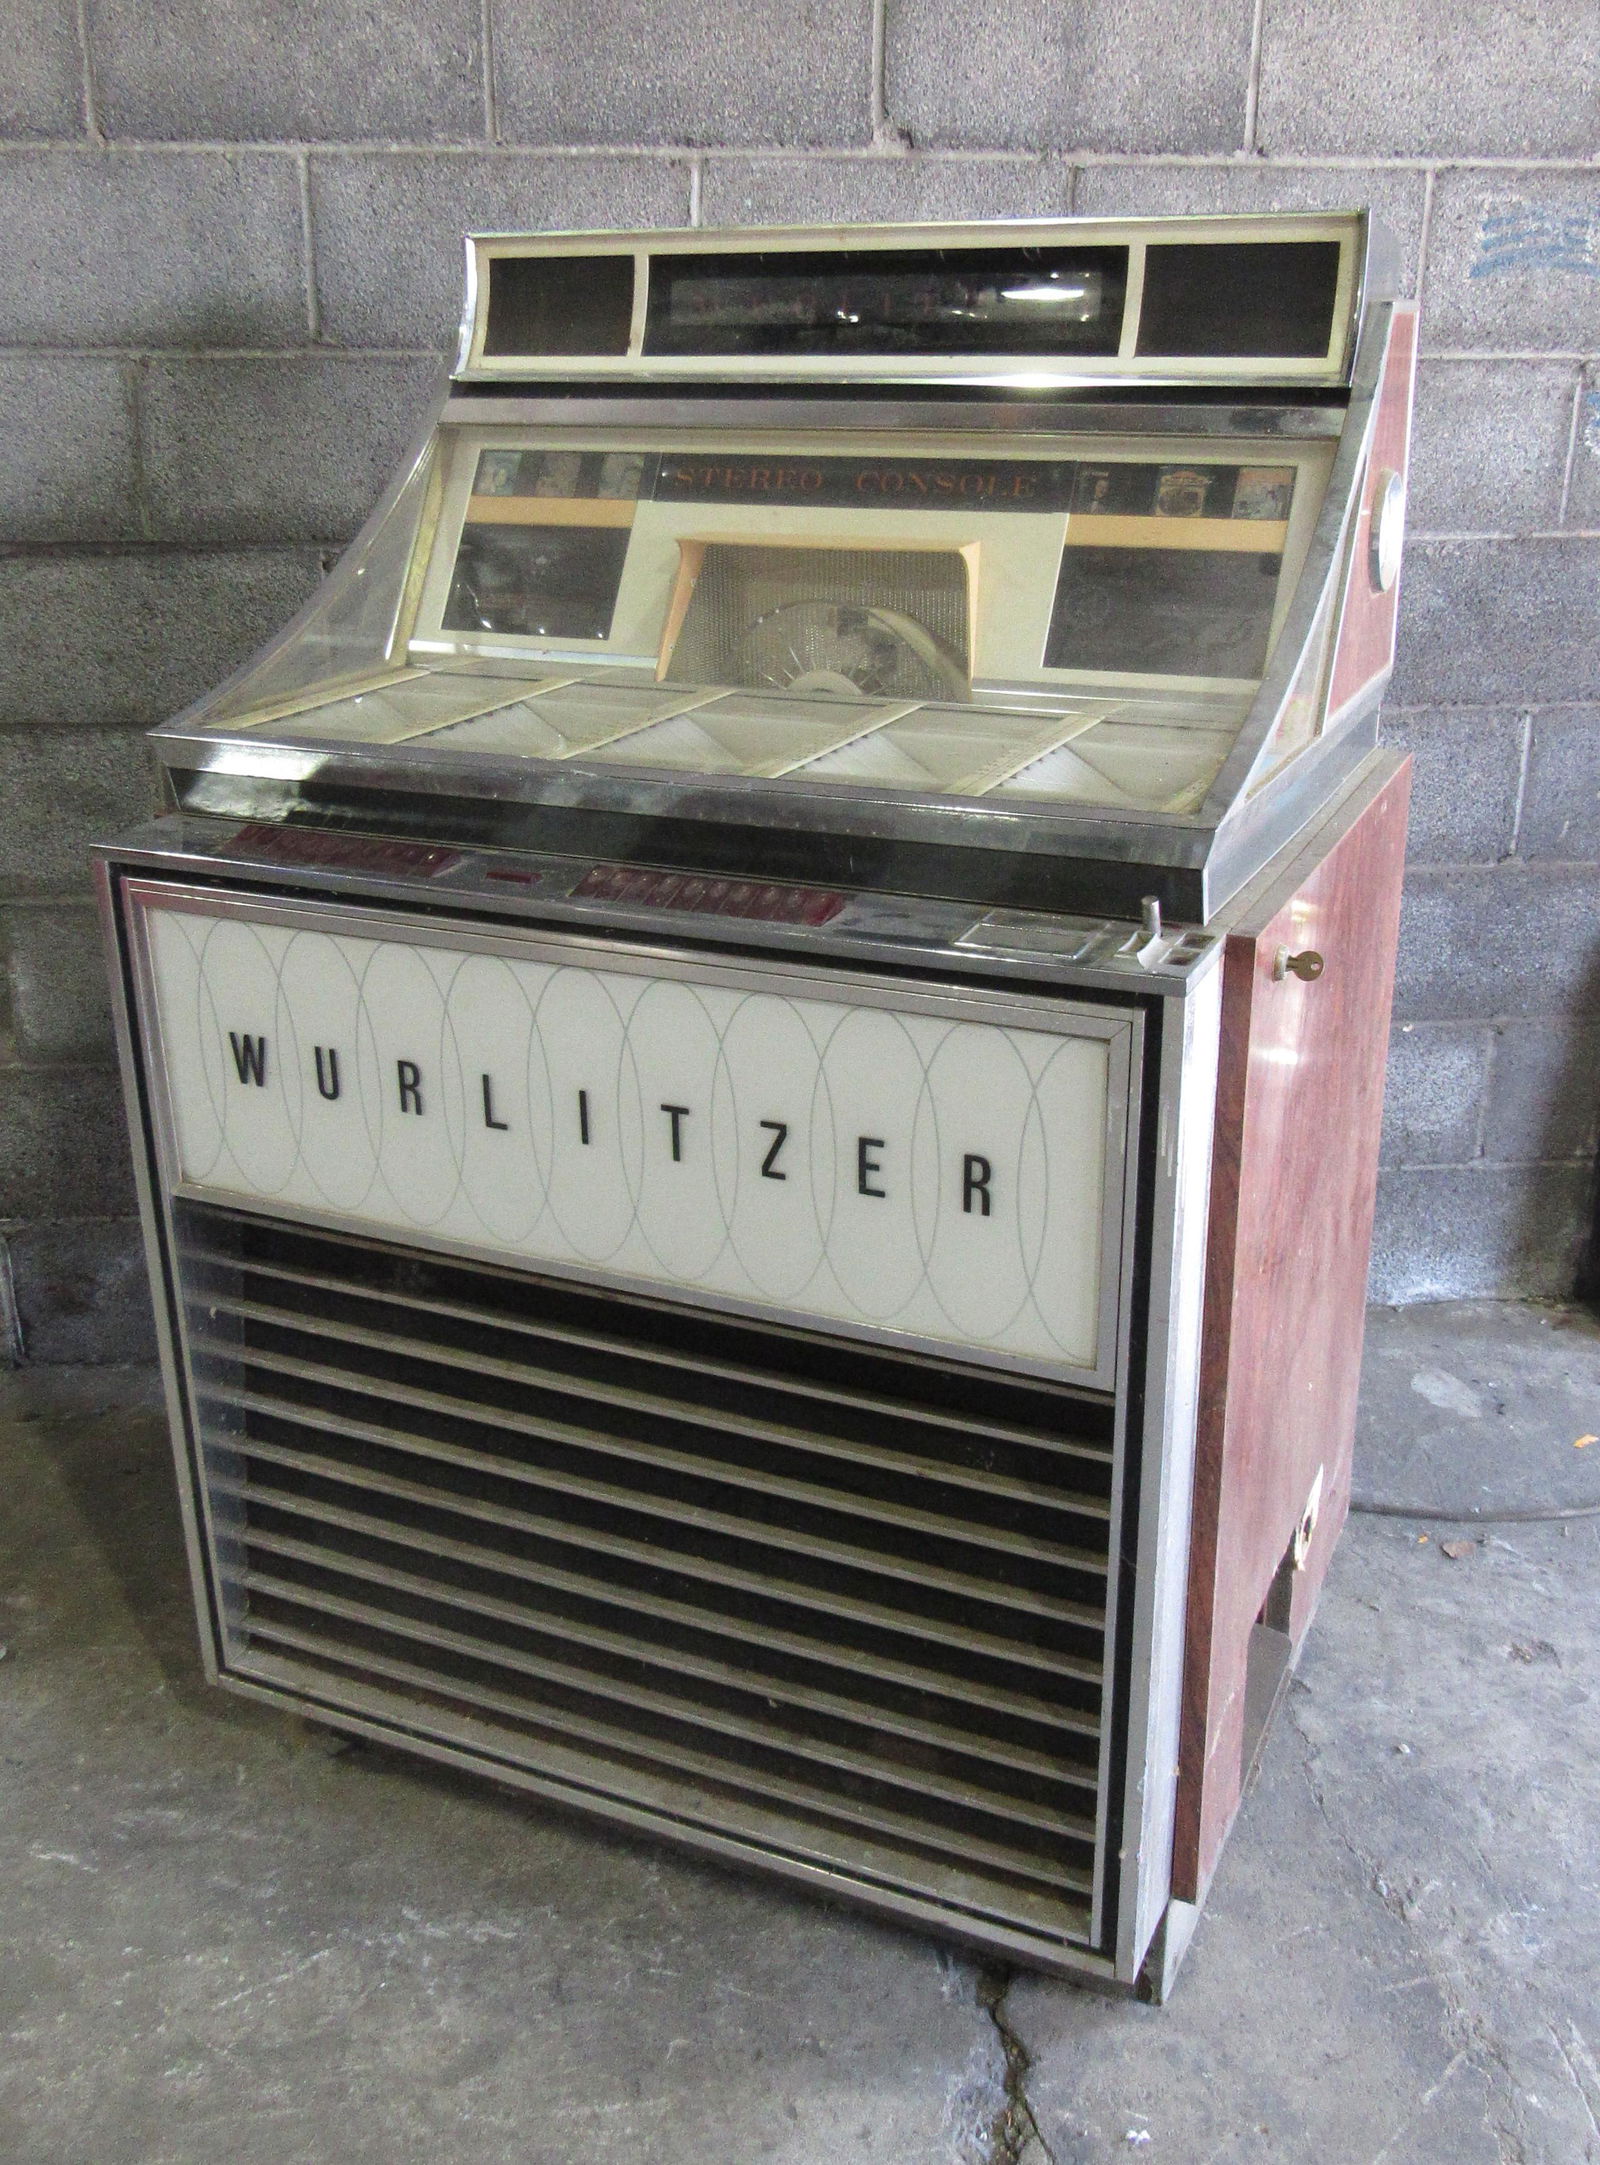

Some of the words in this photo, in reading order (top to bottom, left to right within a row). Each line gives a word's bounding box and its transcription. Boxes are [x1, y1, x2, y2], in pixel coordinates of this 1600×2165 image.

[673, 465, 825, 491] STEREO
[854, 468, 1039, 498] CONSOLE
[229, 1031, 992, 1217] WURLITZER
